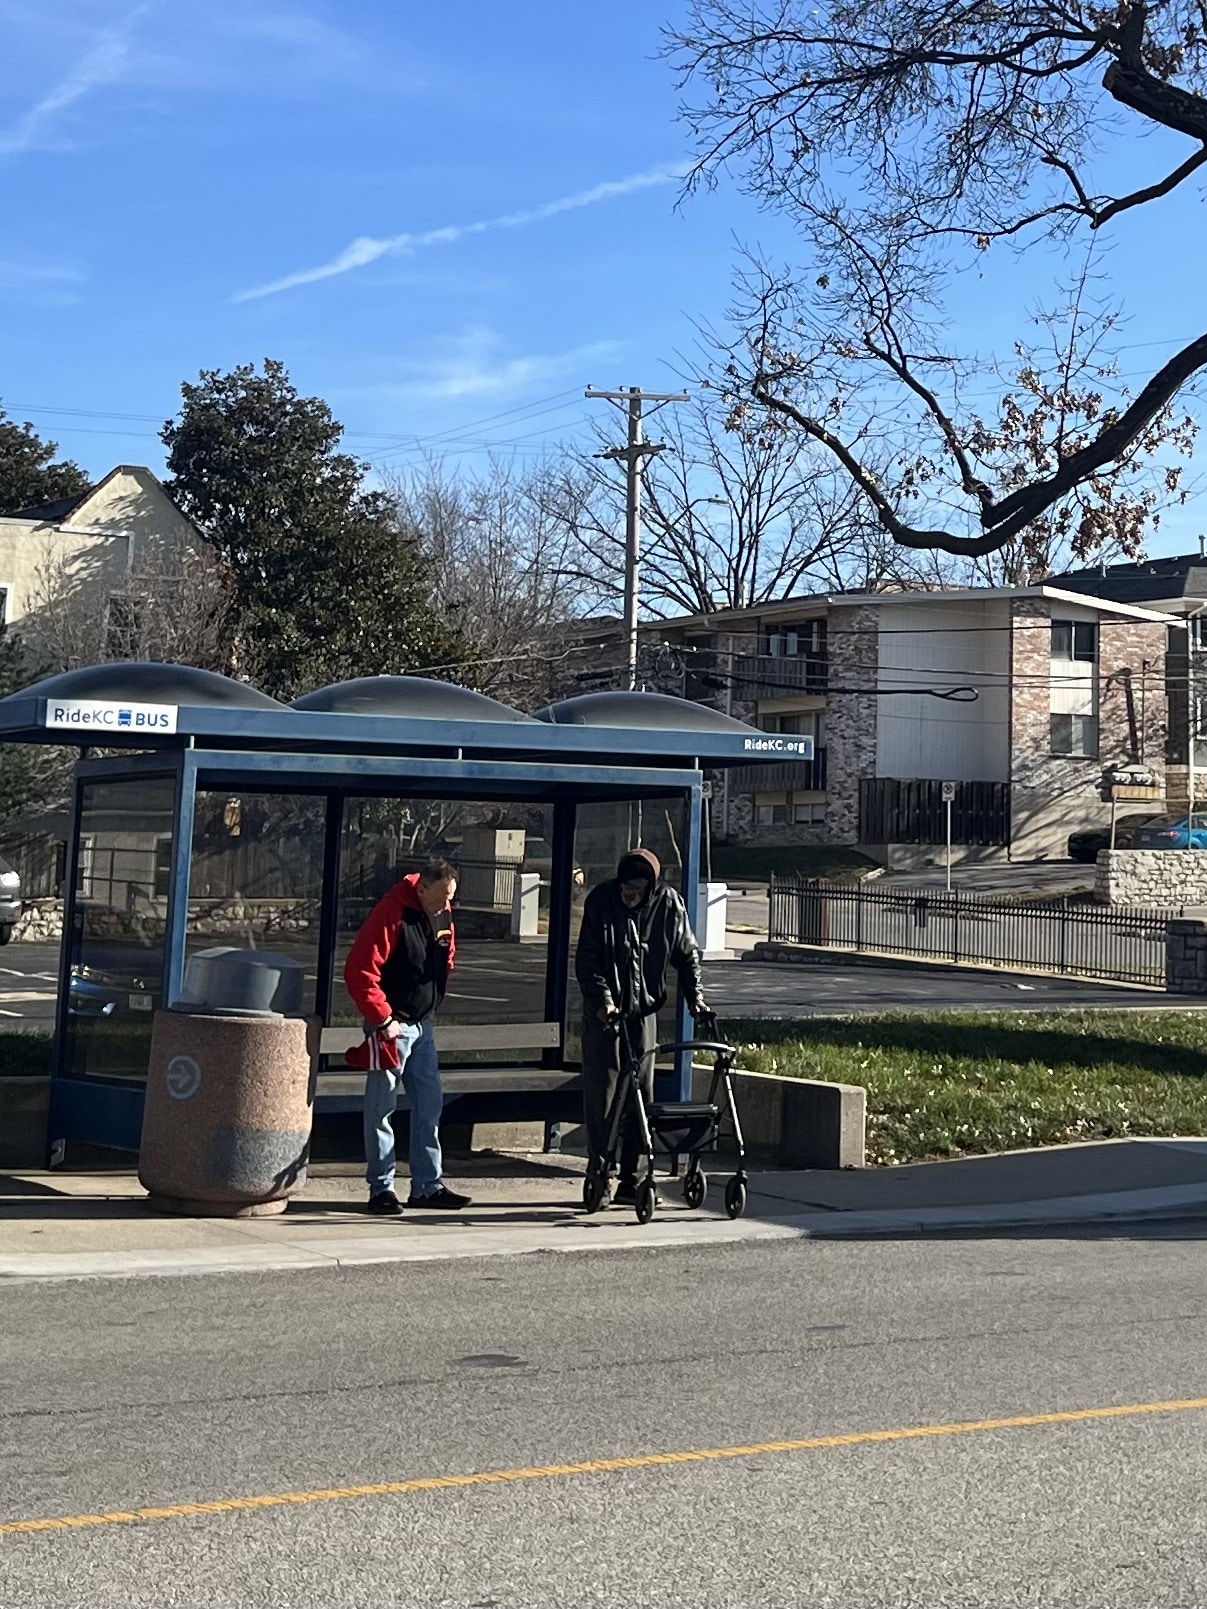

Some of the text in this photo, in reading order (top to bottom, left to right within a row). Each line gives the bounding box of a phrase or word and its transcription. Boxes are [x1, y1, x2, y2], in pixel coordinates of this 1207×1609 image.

[55, 707, 169, 727] RideKC BUS
[744, 739, 805, 754] RideKC.org
